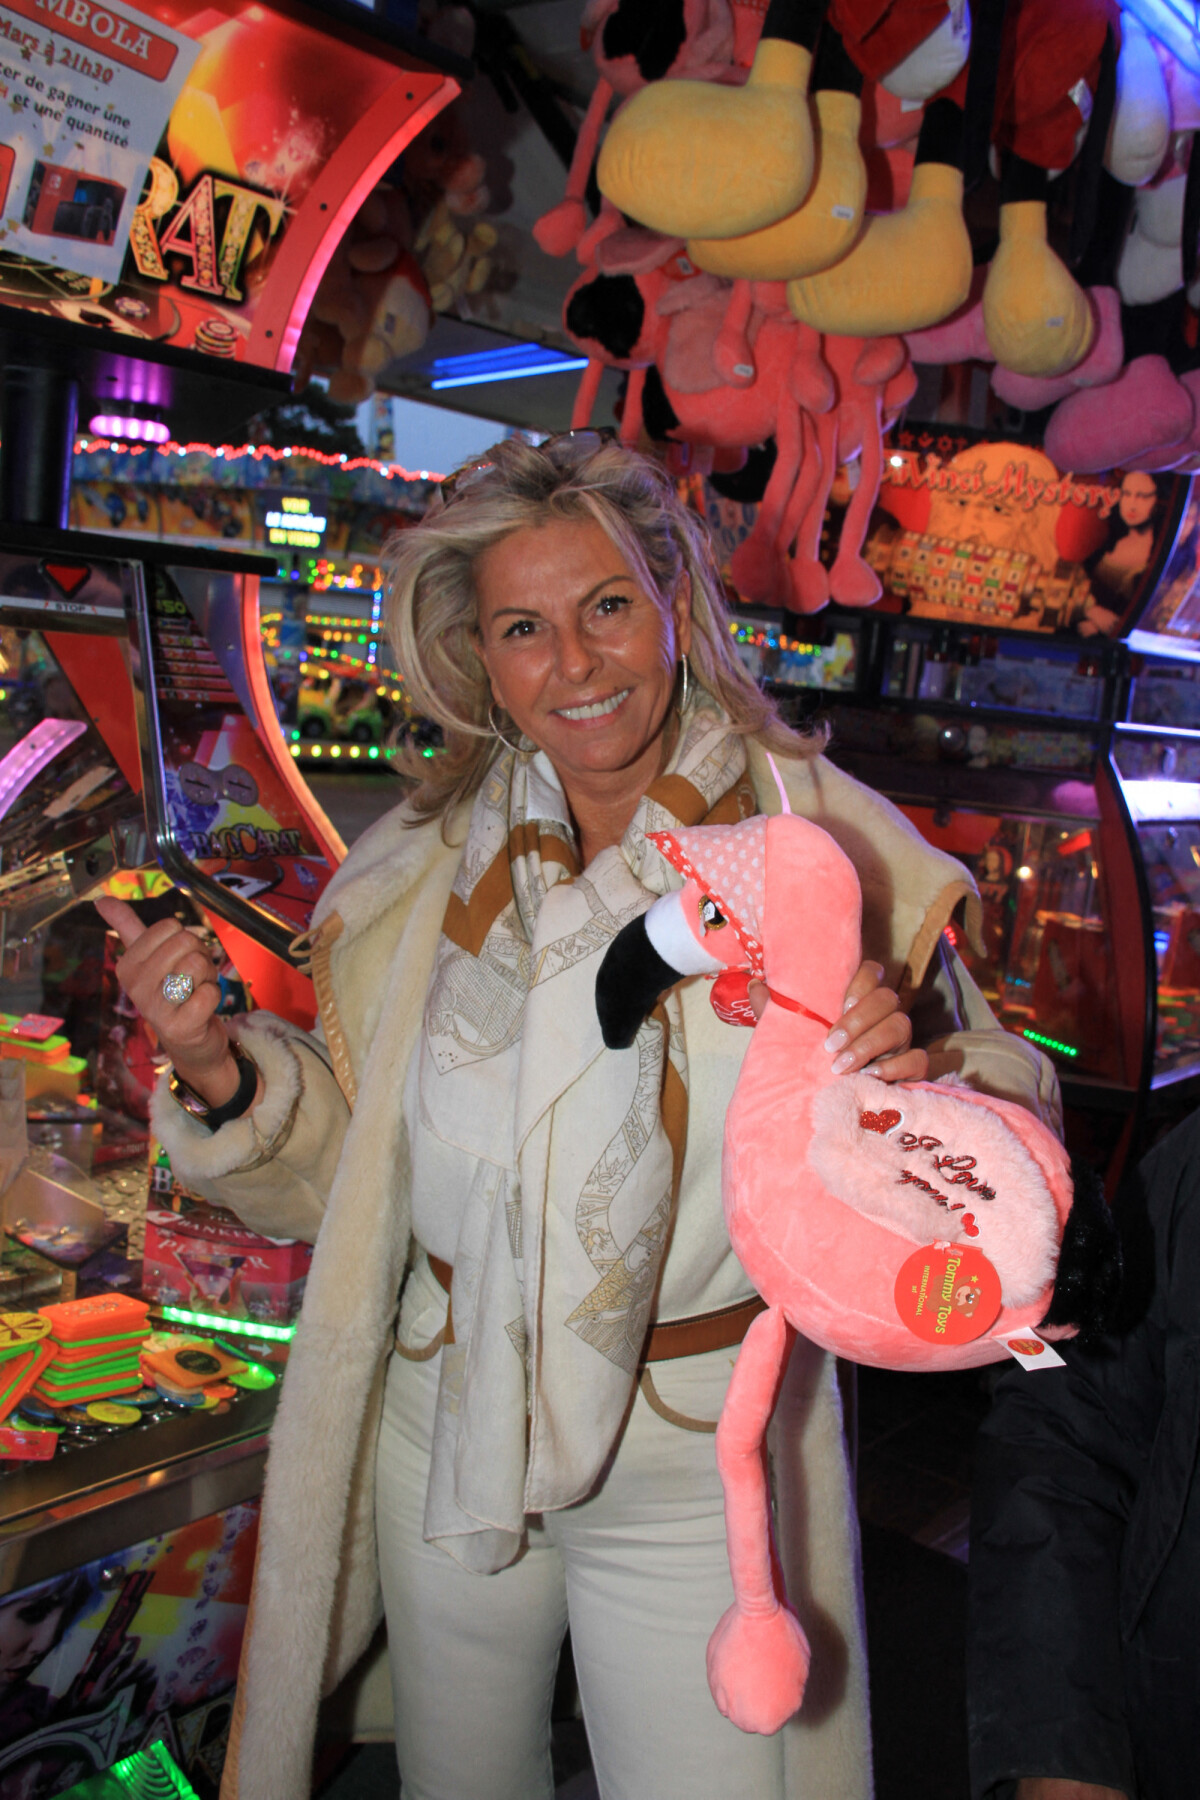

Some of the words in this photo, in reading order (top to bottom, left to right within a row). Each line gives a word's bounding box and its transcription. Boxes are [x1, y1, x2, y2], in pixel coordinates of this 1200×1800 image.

[59, 47, 114, 84] 21h30
[13, 94, 31, 108] et
[34, 102, 62, 121] une
[66, 115, 129, 149] quantité
[25, 75, 45, 92] de
[47, 85, 101, 115] gagner
[103, 107, 131, 129] une
[984, 462, 1122, 520] Mystery
[55, 602, 86, 613] STOP
[190, 823, 301, 861] BACCARAT
[932, 1154, 997, 1201] Love
[177, 1219, 260, 1241] BANKER
[941, 1257, 961, 1303] Tommy
[935, 1305, 952, 1334] Toys
